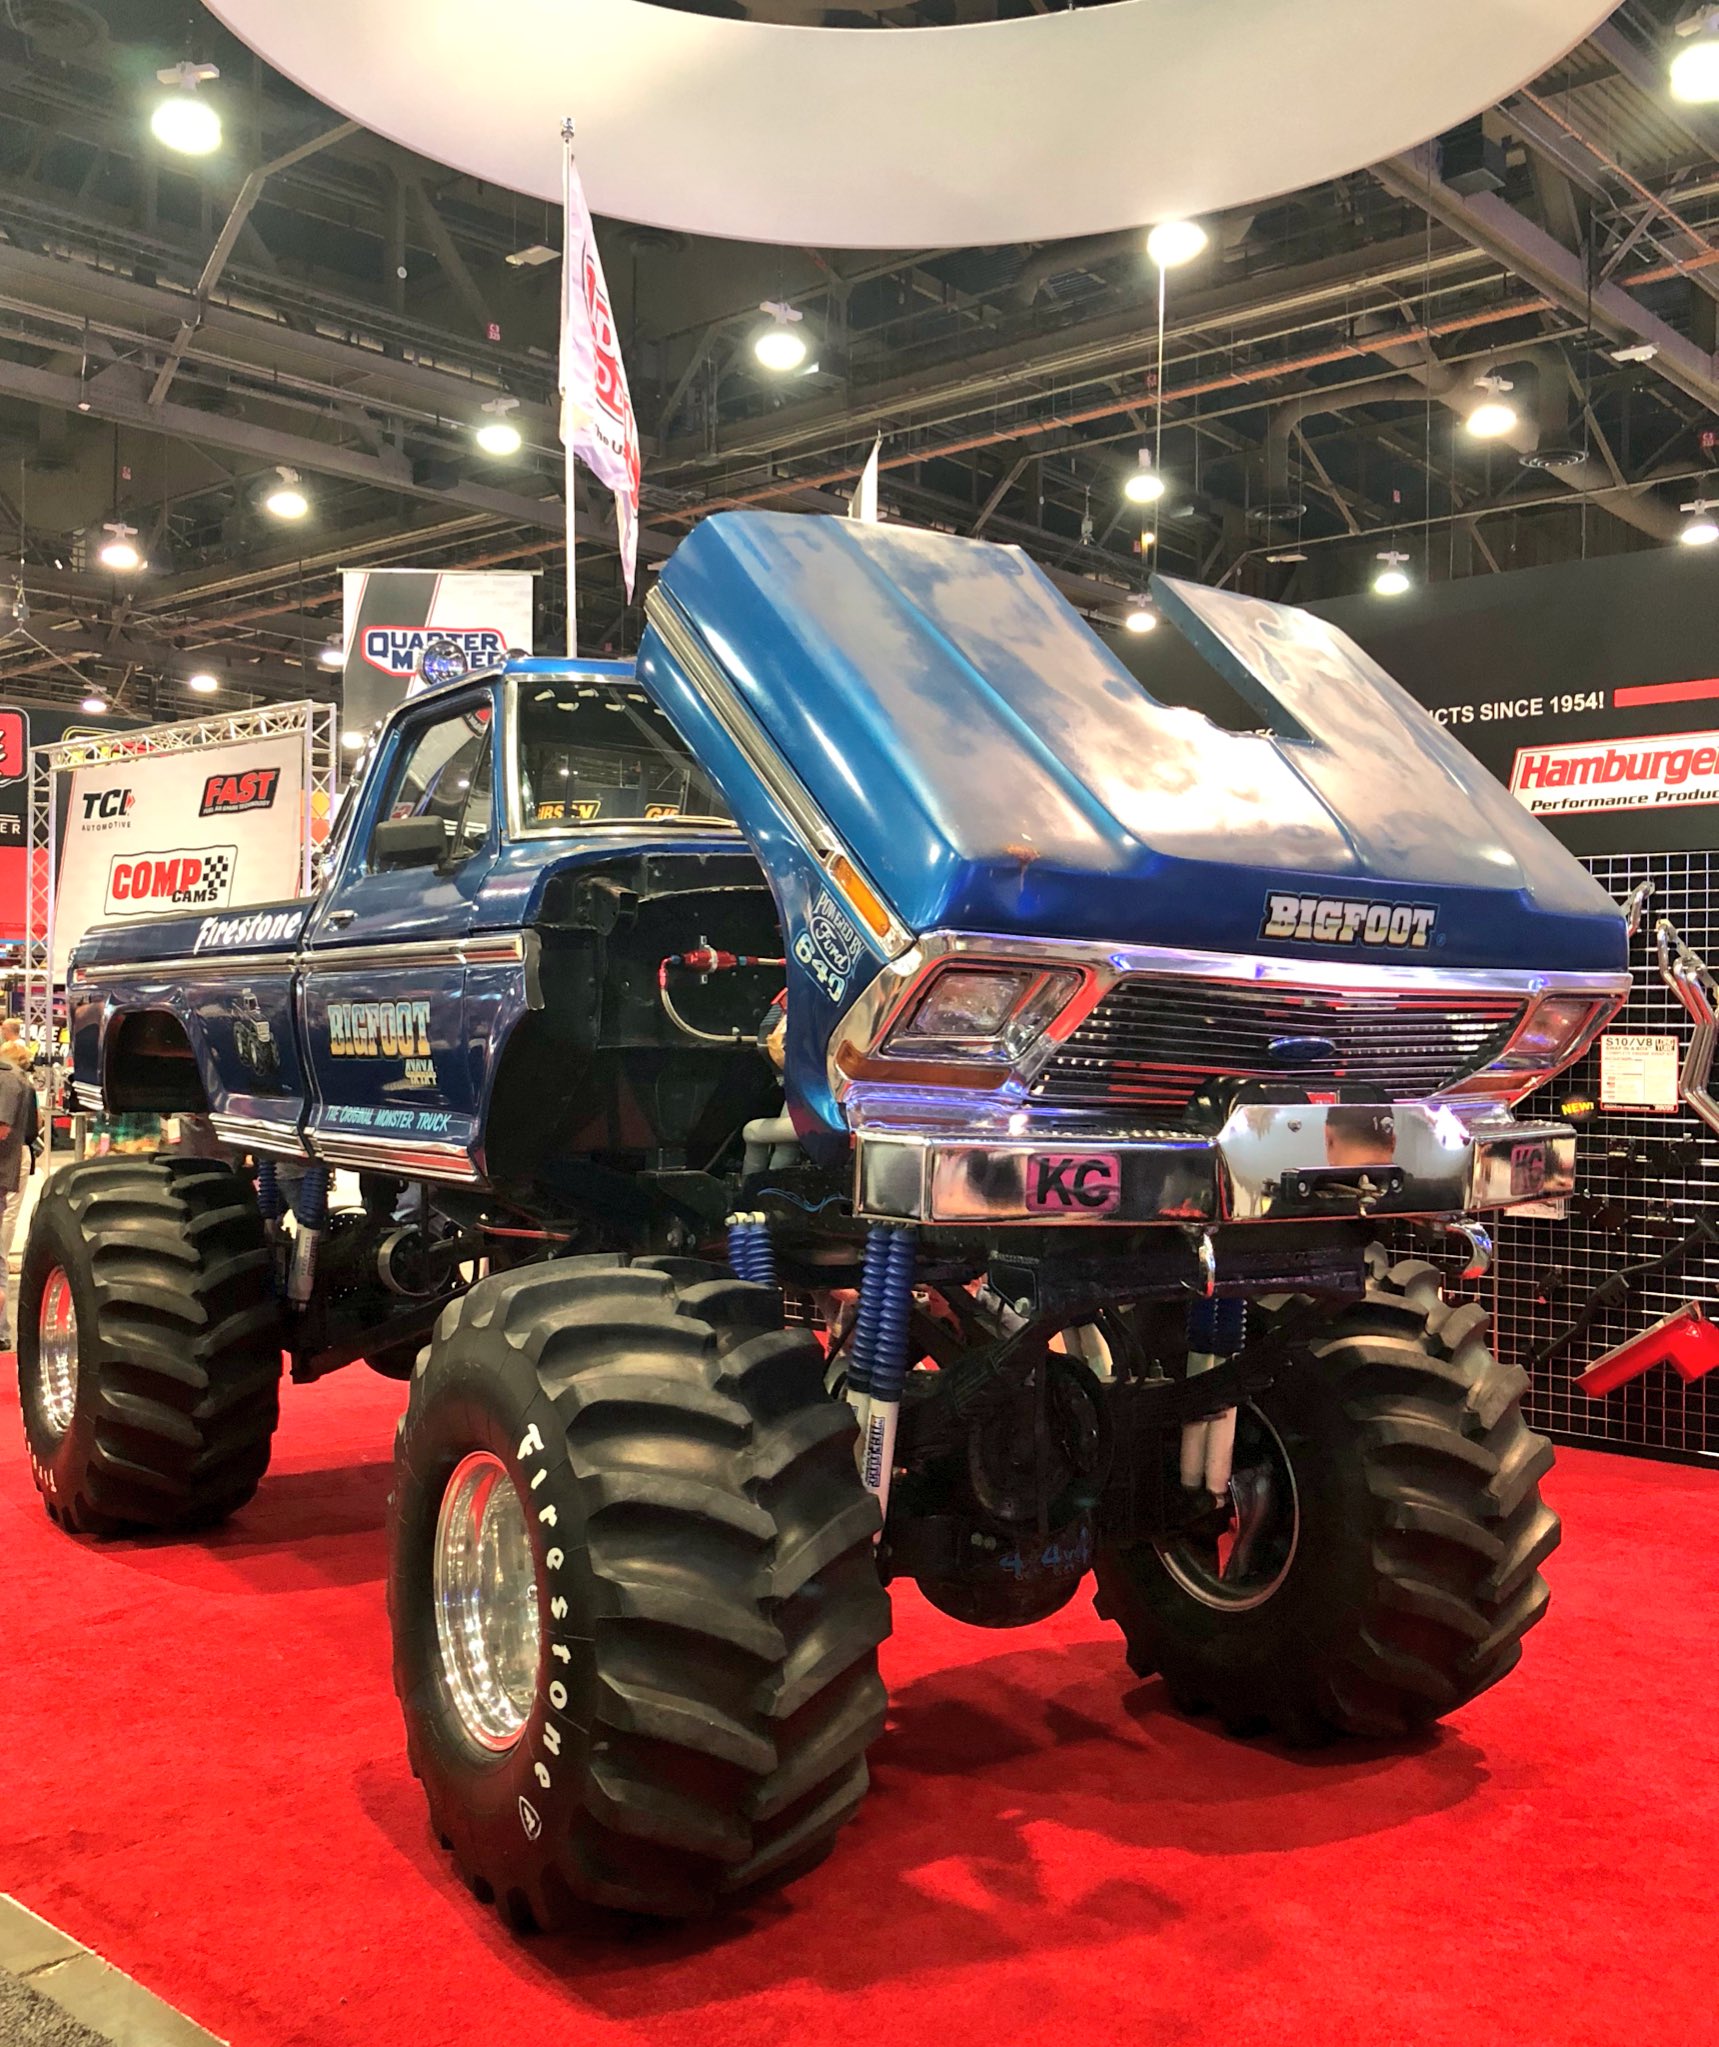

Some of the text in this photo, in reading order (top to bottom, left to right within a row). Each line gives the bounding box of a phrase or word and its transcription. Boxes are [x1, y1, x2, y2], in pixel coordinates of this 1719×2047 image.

[1429, 690, 1605, 726] CTS SINCE 1954!
[82, 788, 134, 819] TCI
[204, 771, 276, 808] FAST
[1530, 793, 1649, 812] Performance
[81, 821, 132, 832] AUTOMOTIVE
[112, 858, 203, 900] COMP
[172, 887, 218, 903] CAMS
[193, 911, 303, 956] Firestone
[813, 890, 866, 965] POWERED BY
[1264, 895, 1436, 947] BIGFOOT
[815, 921, 849, 970] Ford
[327, 1001, 432, 1057] BIGFOOT
[324, 1105, 453, 1133] THE ORIGINAL MONSTER TRUCK
[1561, 1101, 1595, 1116] NEW!
[1036, 1157, 1112, 1208] KC
[516, 1423, 570, 1789] Firestone
